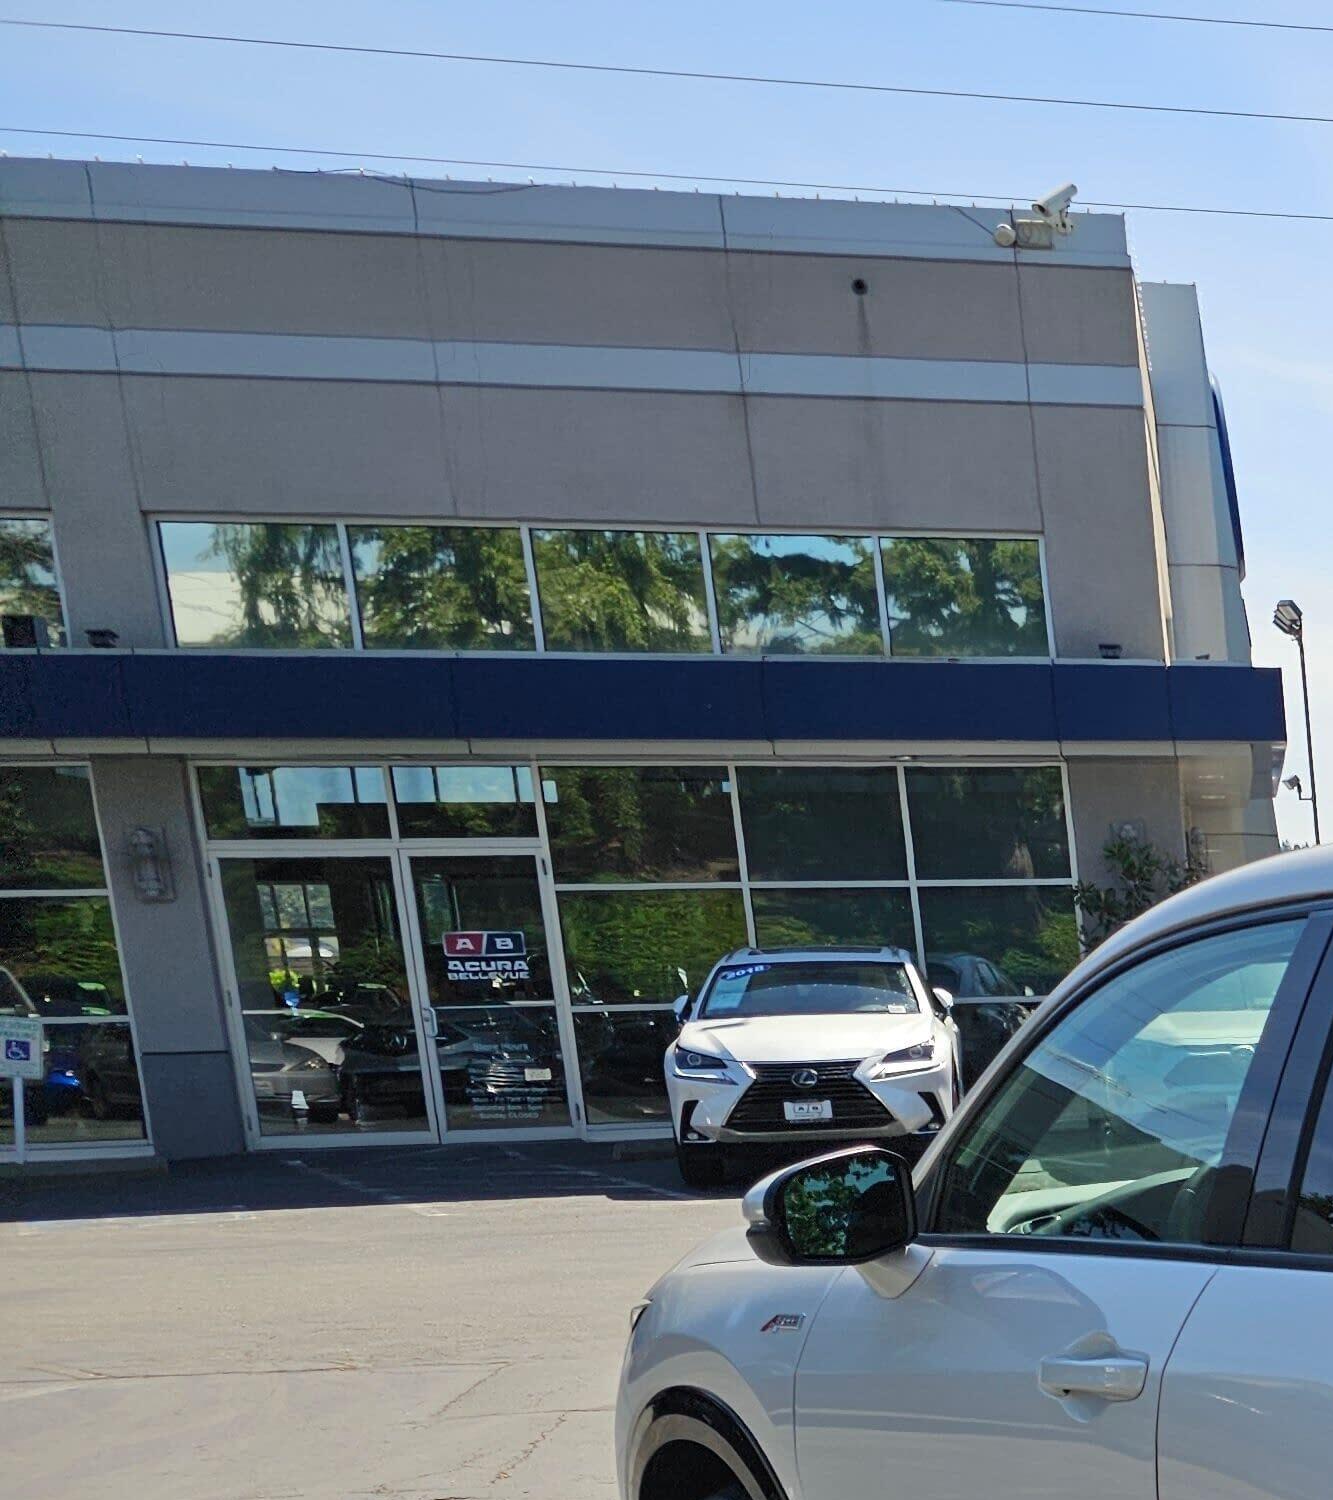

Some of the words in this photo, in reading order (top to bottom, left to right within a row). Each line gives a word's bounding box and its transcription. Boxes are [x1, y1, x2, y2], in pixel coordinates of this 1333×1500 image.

[456, 938, 475, 950] A
[494, 937, 514, 950] B
[447, 960, 529, 972] ACURA
[447, 971, 530, 981] BELLEVUE
